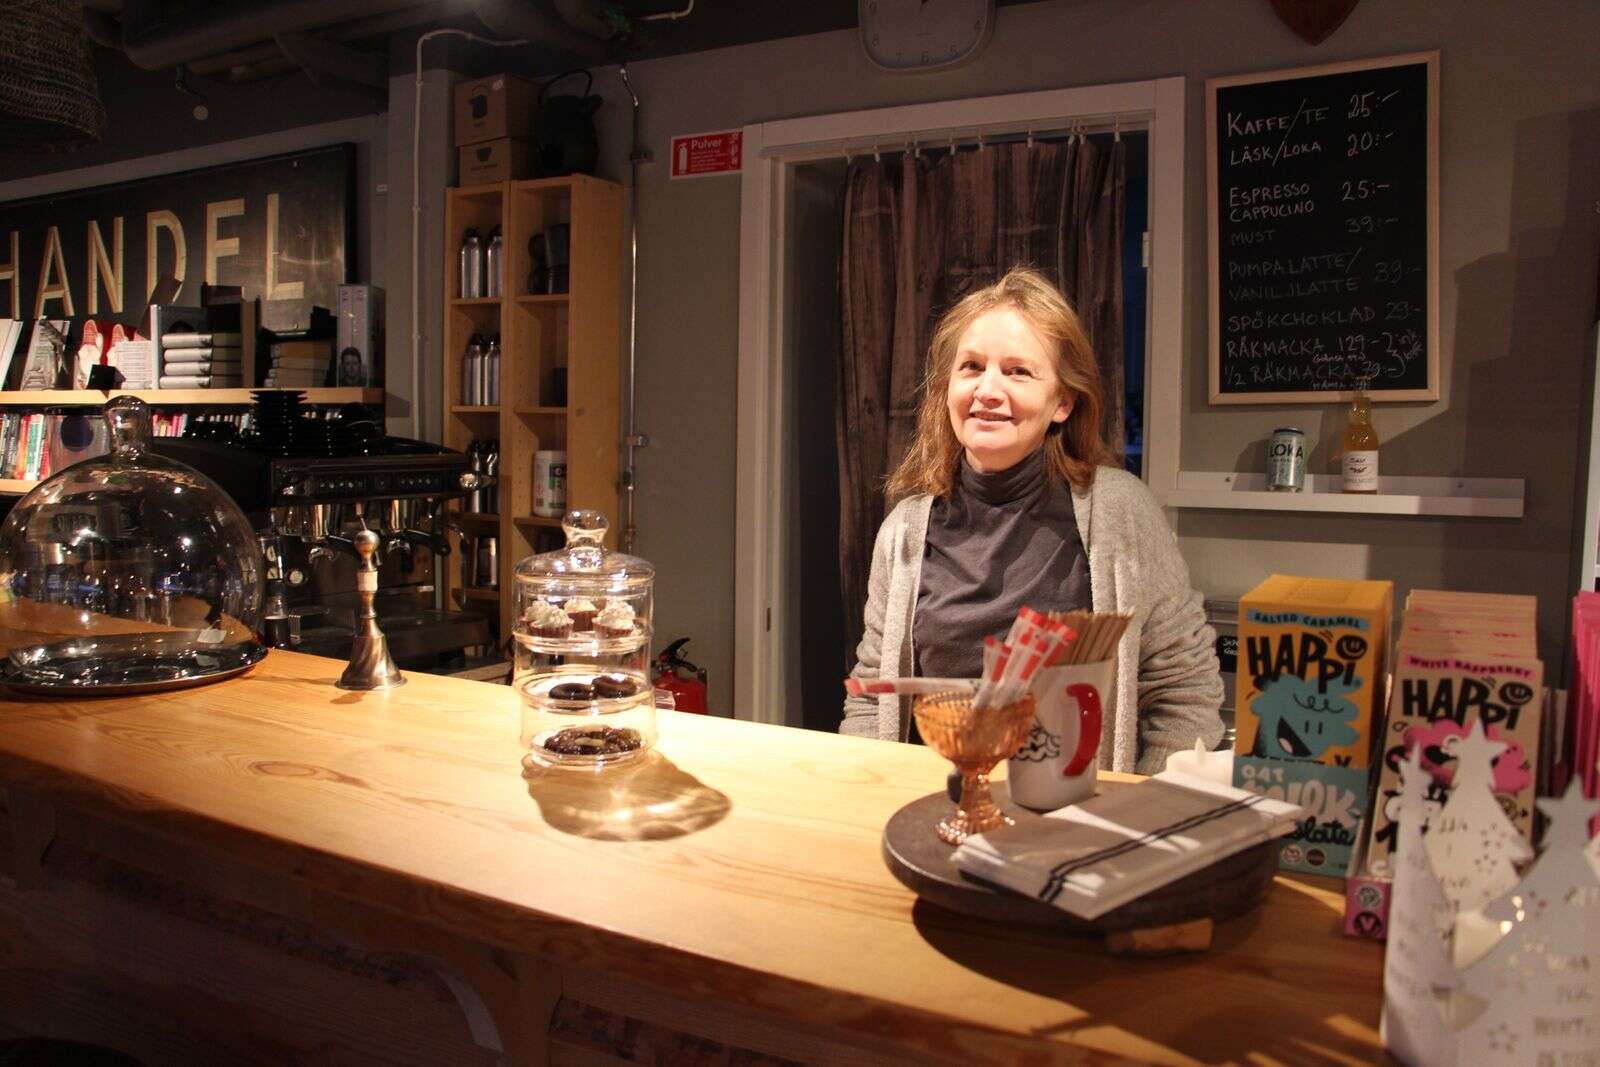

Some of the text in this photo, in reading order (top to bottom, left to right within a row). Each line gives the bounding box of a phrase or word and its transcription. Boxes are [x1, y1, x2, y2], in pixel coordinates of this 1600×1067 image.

[691, 138, 722, 150] Pulver
[1229, 200, 1315, 223] CAPPUCINO
[1230, 229, 1276, 247] MUST
[1269, 443, 1304, 459] LOKA
[1254, 611, 1361, 628] SALTED CARAMEL
[1410, 655, 1532, 678] WHITE RASPBERRY
